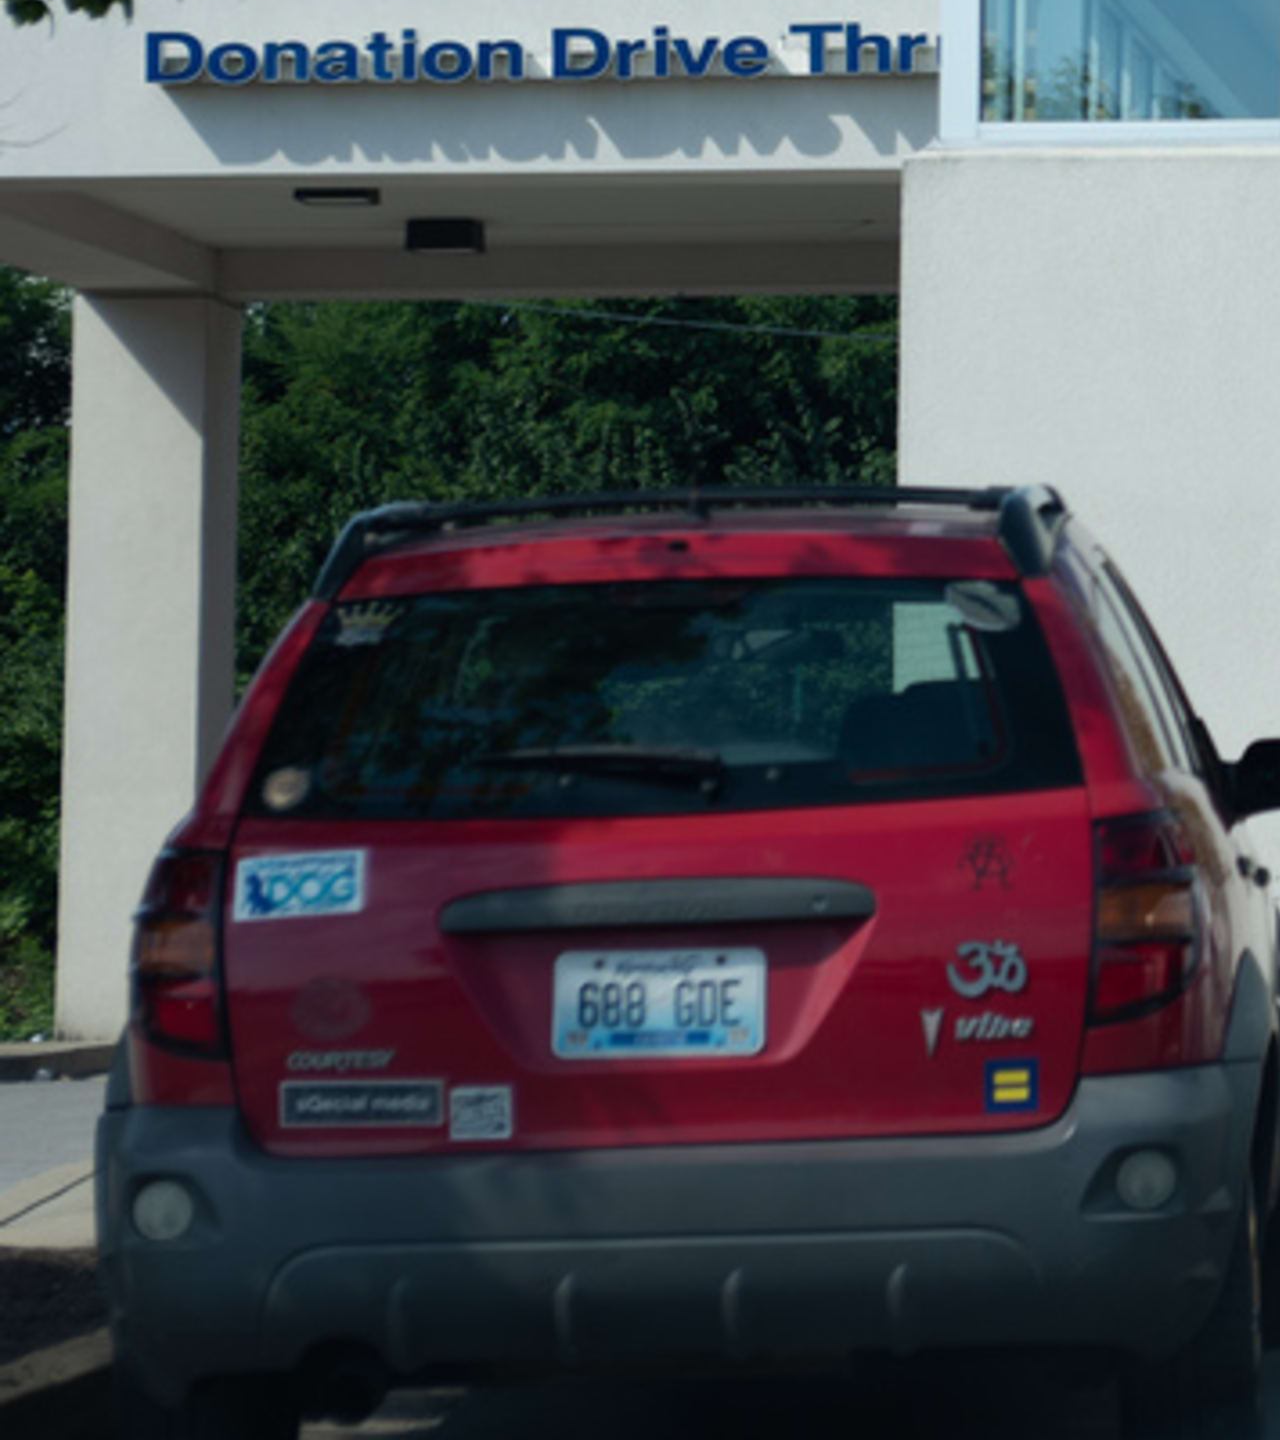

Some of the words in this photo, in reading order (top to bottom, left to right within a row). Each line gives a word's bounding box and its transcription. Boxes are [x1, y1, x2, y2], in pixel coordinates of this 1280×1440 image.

[145, 28, 524, 85] Donation
[550, 25, 770, 79] Drive
[788, 21, 941, 75] Thr
[577, 981, 647, 1030] 688
[673, 978, 742, 1029] GDE
[954, 1012, 1034, 1041] vibe
[286, 1048, 398, 1072] COURTESY
